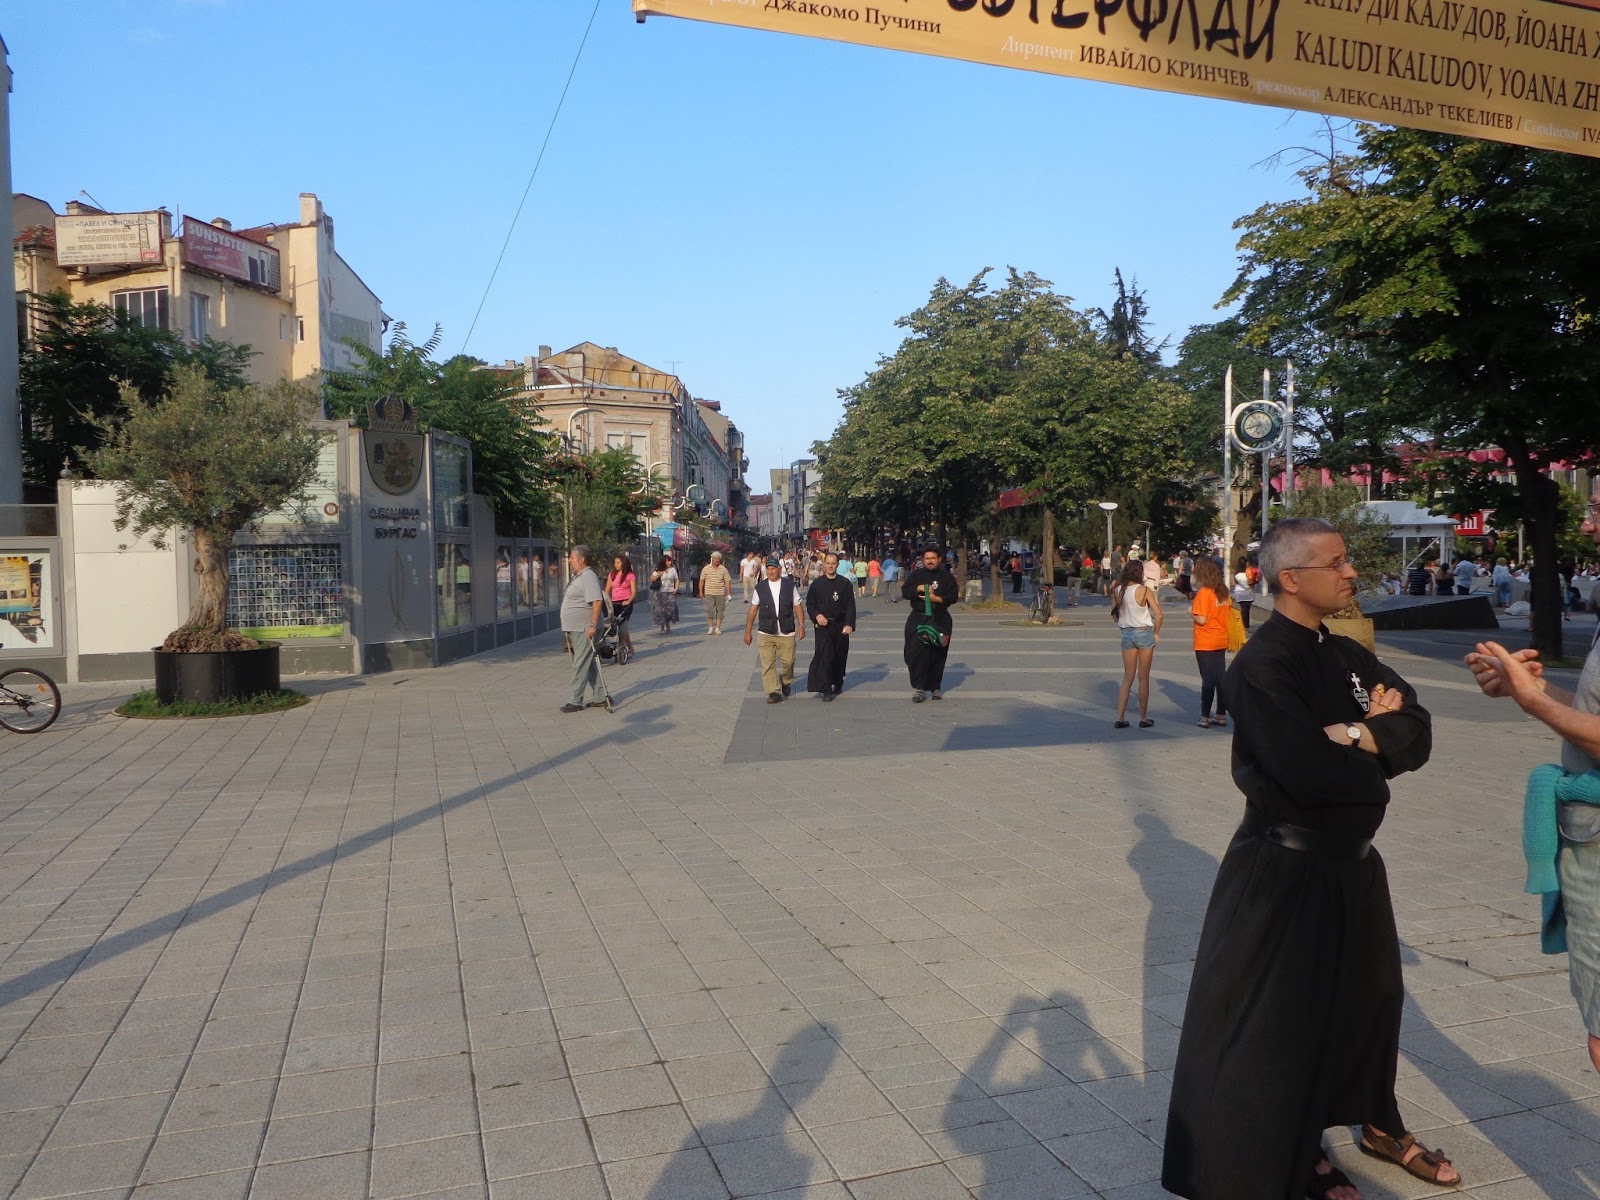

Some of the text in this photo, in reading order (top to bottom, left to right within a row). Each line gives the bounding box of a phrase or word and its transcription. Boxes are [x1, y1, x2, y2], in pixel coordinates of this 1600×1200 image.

[764, 0, 942, 34] Джакомо Пучини
[1515, 8, 1588, 58] ЙОАНА
[1001, 35, 1075, 63] Диригент
[1079, 44, 1162, 74] ИВАЙЛО
[1166, 58, 1254, 90] КРИНЧЕВ,
[1323, 86, 1435, 117] АЛЕКСАНДЪР
[1437, 103, 1513, 130] ТЕКЕЛИЕВ
[1294, 30, 1382, 75] KALUDI
[1386, 46, 1493, 100] KALUDOV,
[1500, 66, 1568, 107] YOANA
[1524, 119, 1580, 141] Conductor
[375, 527, 417, 539] БУРГАС
